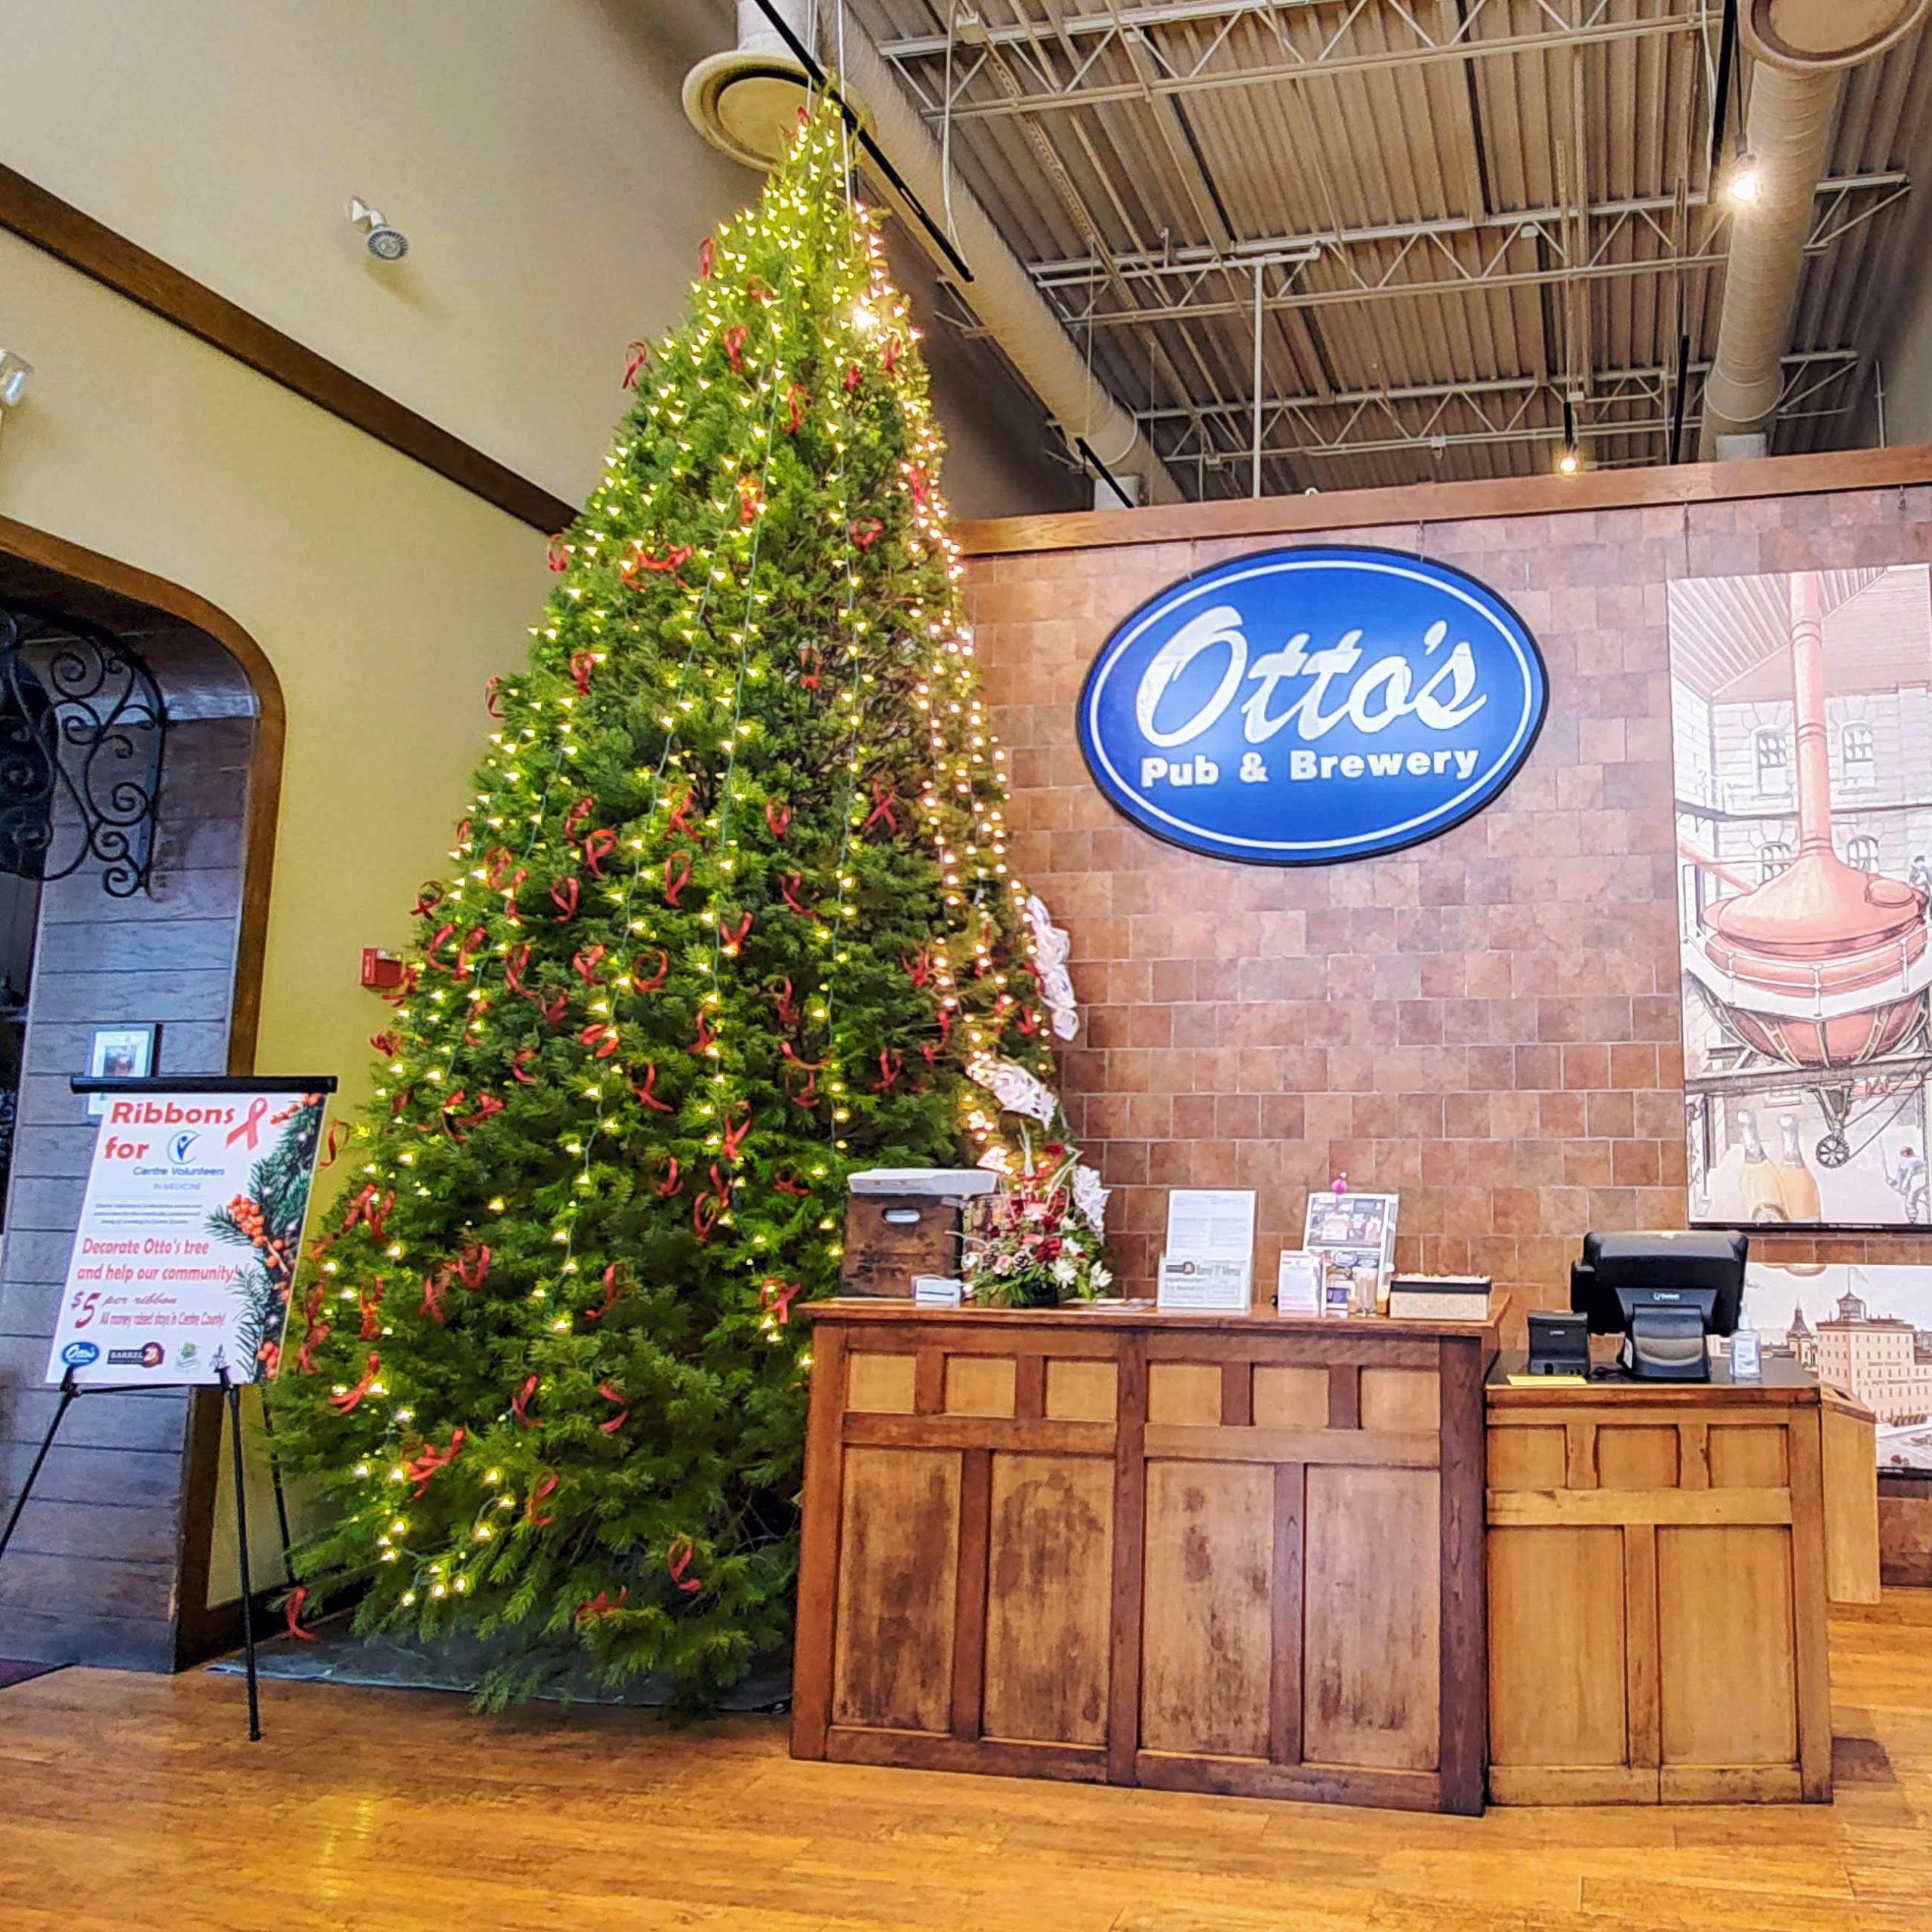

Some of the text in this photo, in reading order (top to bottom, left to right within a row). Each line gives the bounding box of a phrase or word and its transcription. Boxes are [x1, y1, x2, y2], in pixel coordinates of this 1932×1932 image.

[1136, 605, 1487, 749] Otto's
[1141, 749, 1479, 788] Pub & Brewery
[110, 1102, 235, 1124] Ribbons
[105, 1136, 149, 1159] for
[171, 1166, 225, 1176] Volunteers
[82, 1238, 209, 1254] Decorate Otto's tree
[77, 1263, 239, 1283] and help our community!
[102, 1295, 128, 1306] per
[133, 1292, 177, 1304] ribbon
